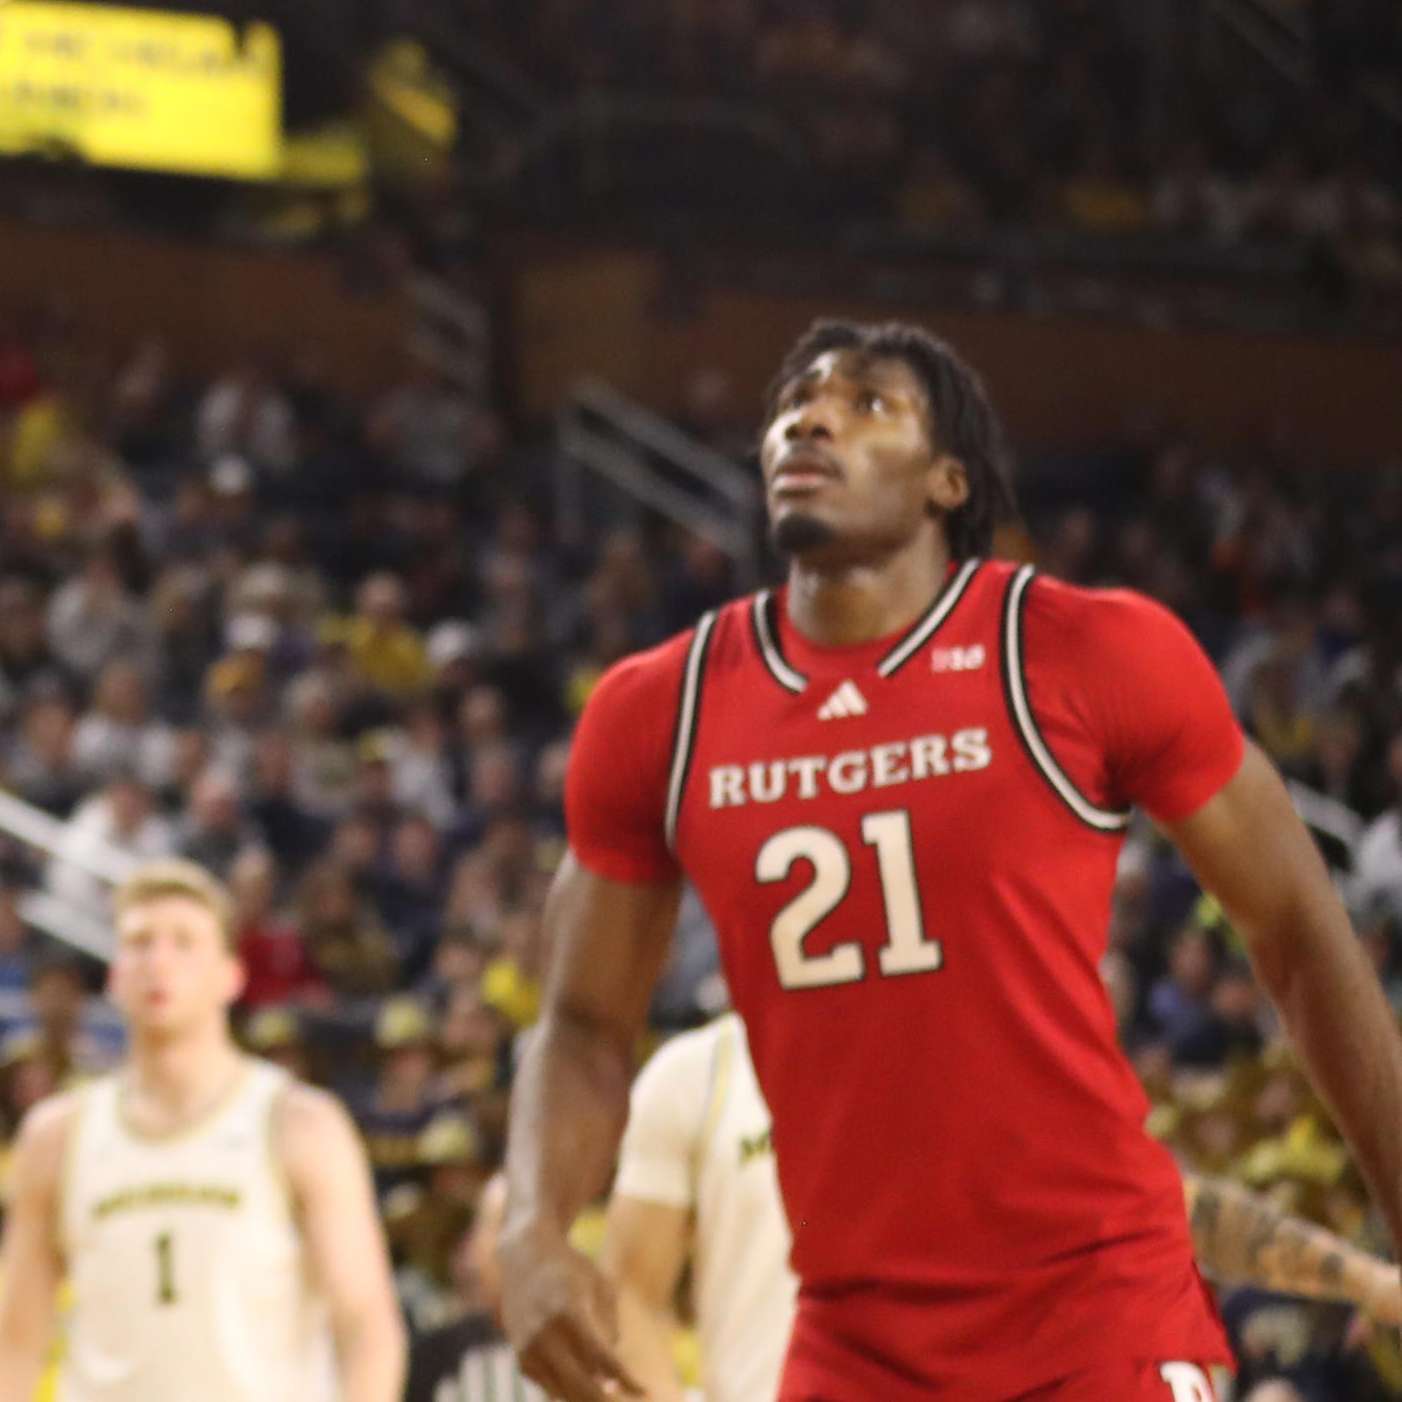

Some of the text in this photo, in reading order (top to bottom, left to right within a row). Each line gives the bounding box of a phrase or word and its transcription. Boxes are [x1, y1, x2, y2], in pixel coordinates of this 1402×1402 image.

[708, 727, 993, 809] RUTGERS
[754, 808, 944, 991] 21
[154, 1231, 179, 1304] 1
